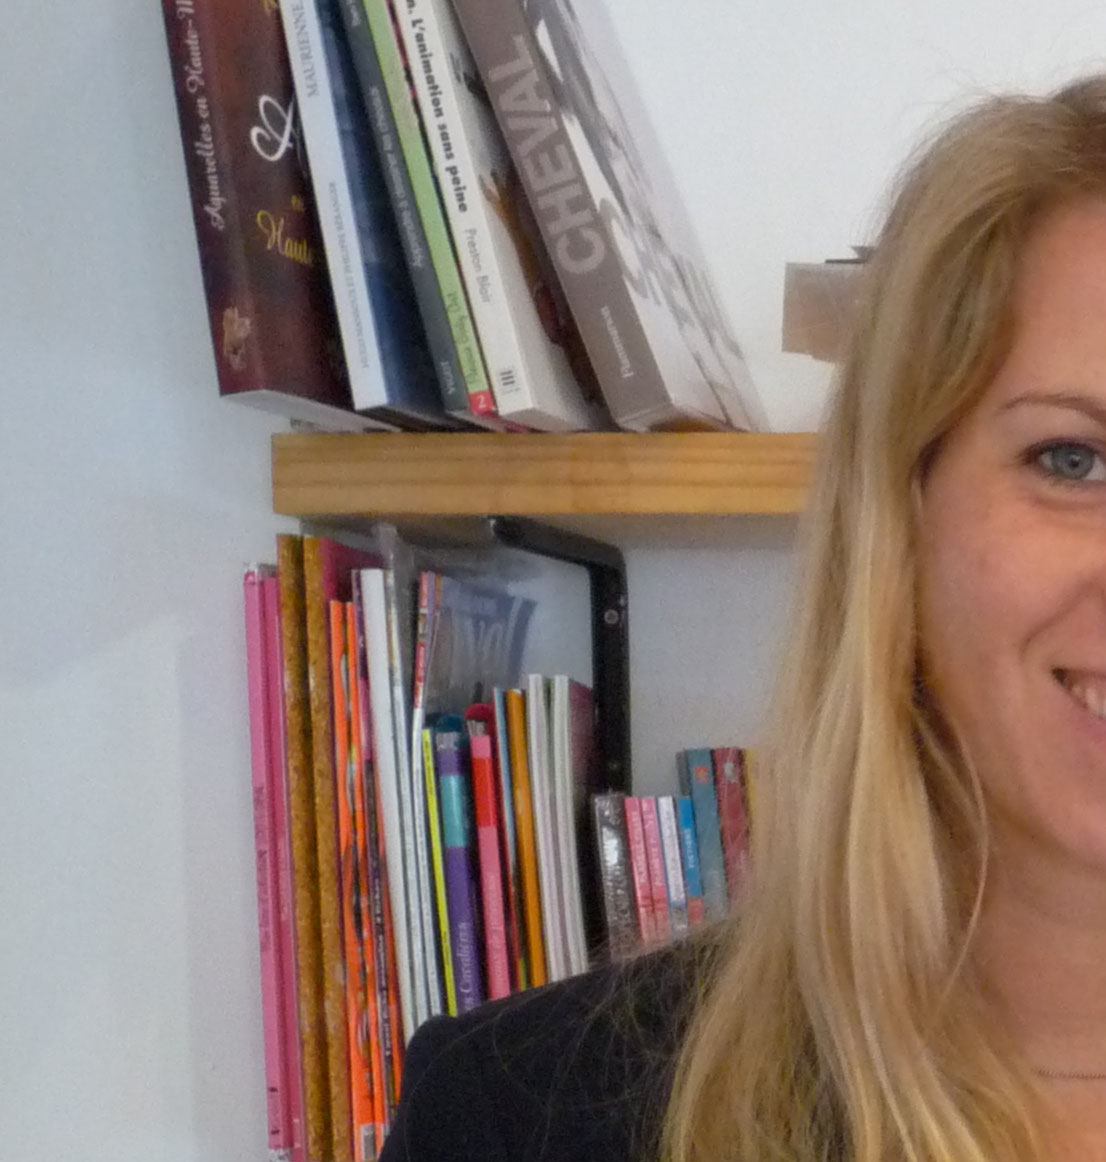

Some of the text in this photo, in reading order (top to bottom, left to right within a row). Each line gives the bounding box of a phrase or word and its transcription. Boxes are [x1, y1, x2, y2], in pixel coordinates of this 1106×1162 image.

[411, 18, 444, 118] L'animation
[194, 123, 226, 231] Aquarelles
[437, 122, 455, 160] sans
[488, 33, 606, 275] CHEVAL
[445, 165, 468, 213] peine
[465, 228, 492, 303] Preston Blair
